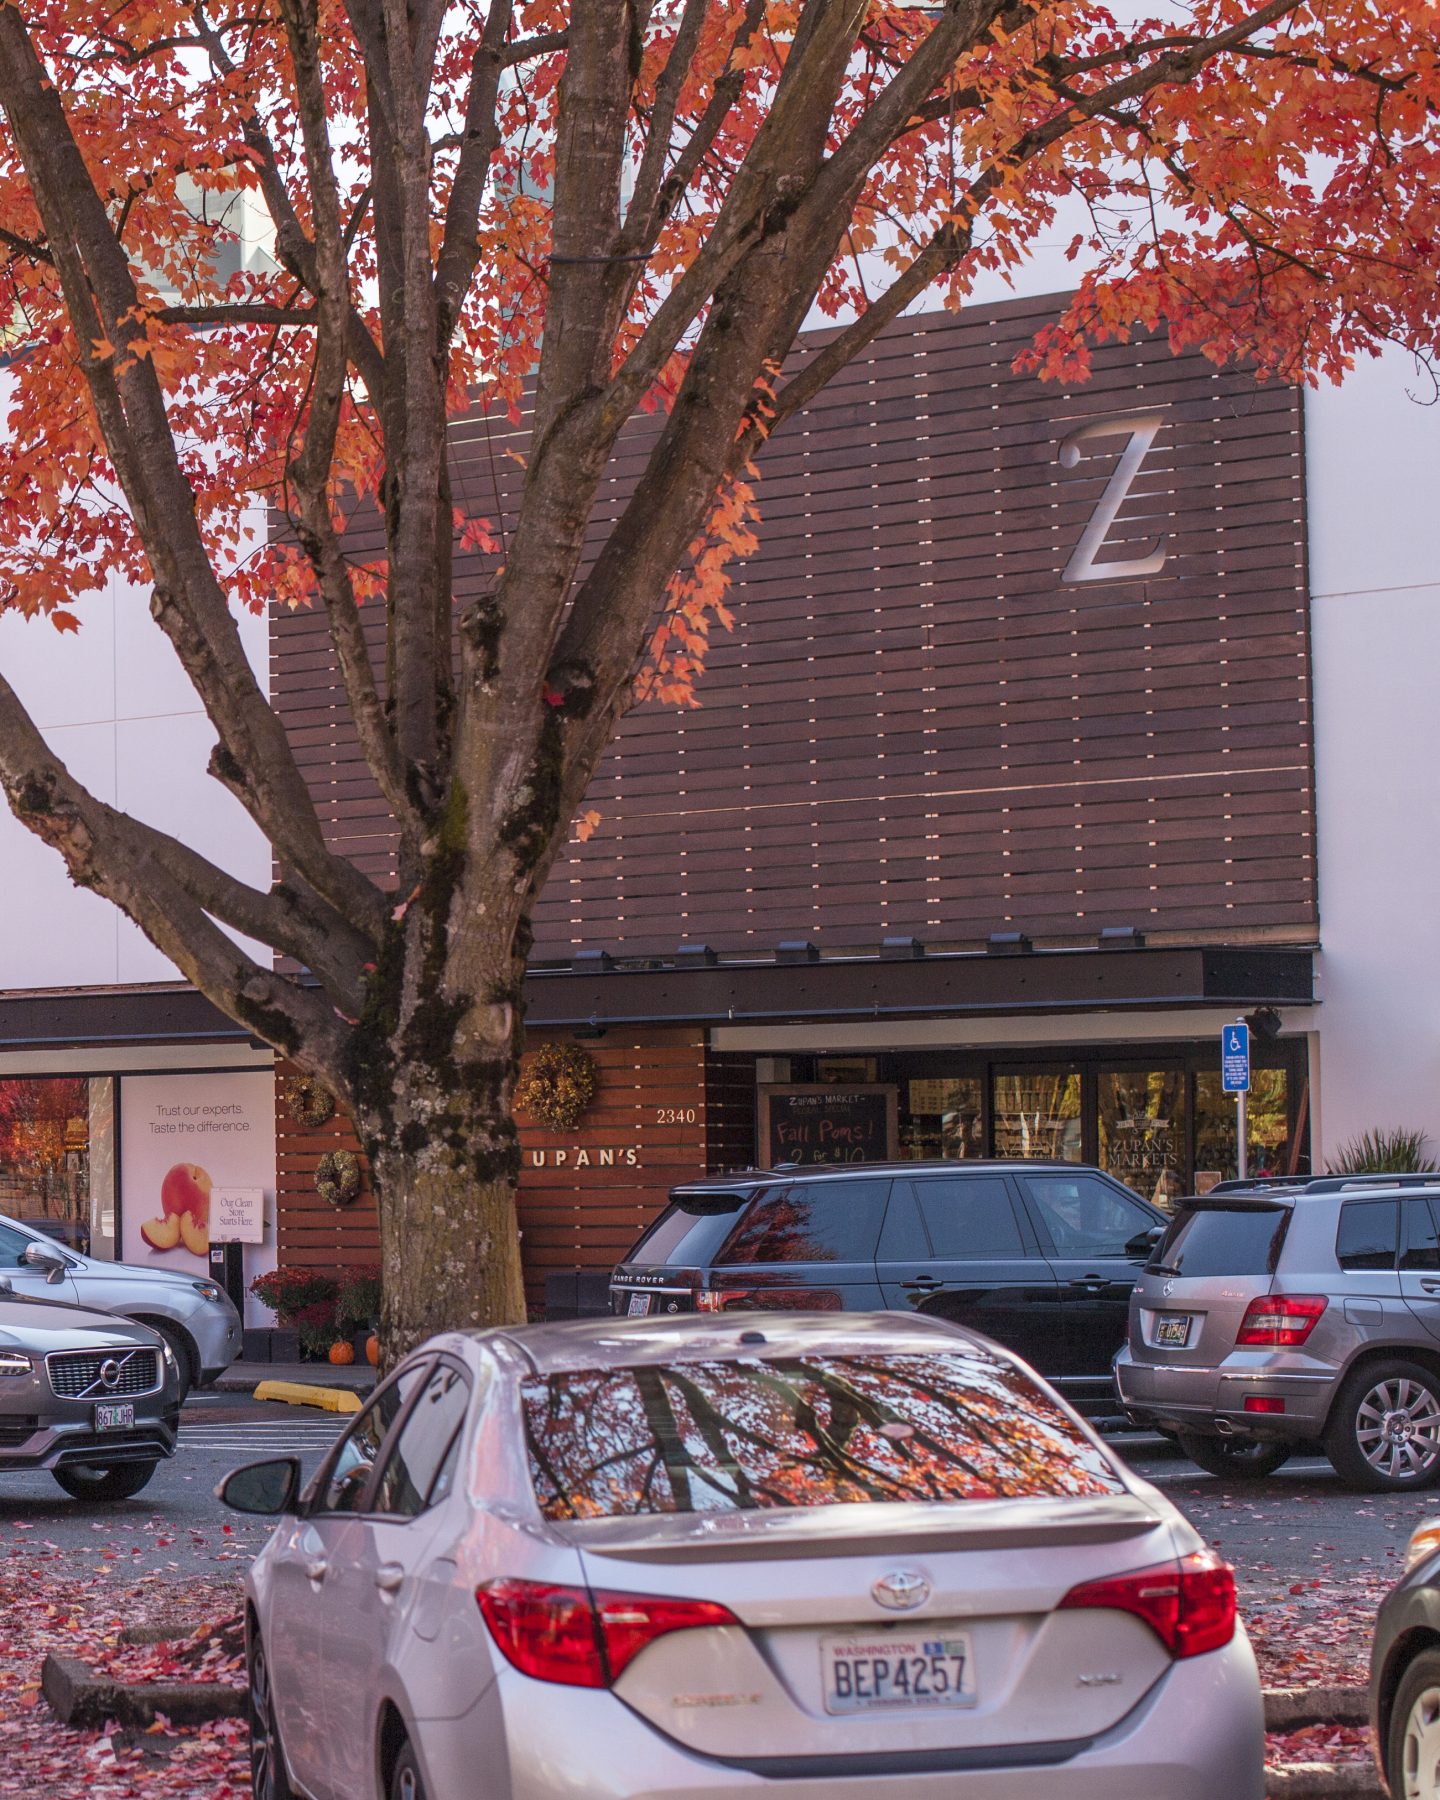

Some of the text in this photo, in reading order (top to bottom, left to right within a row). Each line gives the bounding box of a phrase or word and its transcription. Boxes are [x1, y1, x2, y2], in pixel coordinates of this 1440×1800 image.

[1058, 414, 1167, 583] Z
[155, 1103, 244, 1118] Trust our experts.
[656, 1109, 695, 1124] 2340
[149, 1120, 252, 1134] Taste the difference.
[777, 1121, 808, 1144] Fall
[532, 1149, 637, 1166] UPAN'S
[1109, 1153, 1177, 1166] MARKETS
[220, 1197, 253, 1208] Our Clean
[229, 1208, 245, 1217] Store
[219, 1217, 253, 1226] Starts Here
[636, 1276, 664, 1284] ROVER
[97, 1408, 133, 1425] 867 JHR
[832, 1644, 916, 1657] WASHINGTON
[833, 1656, 966, 1698] BEP4257
